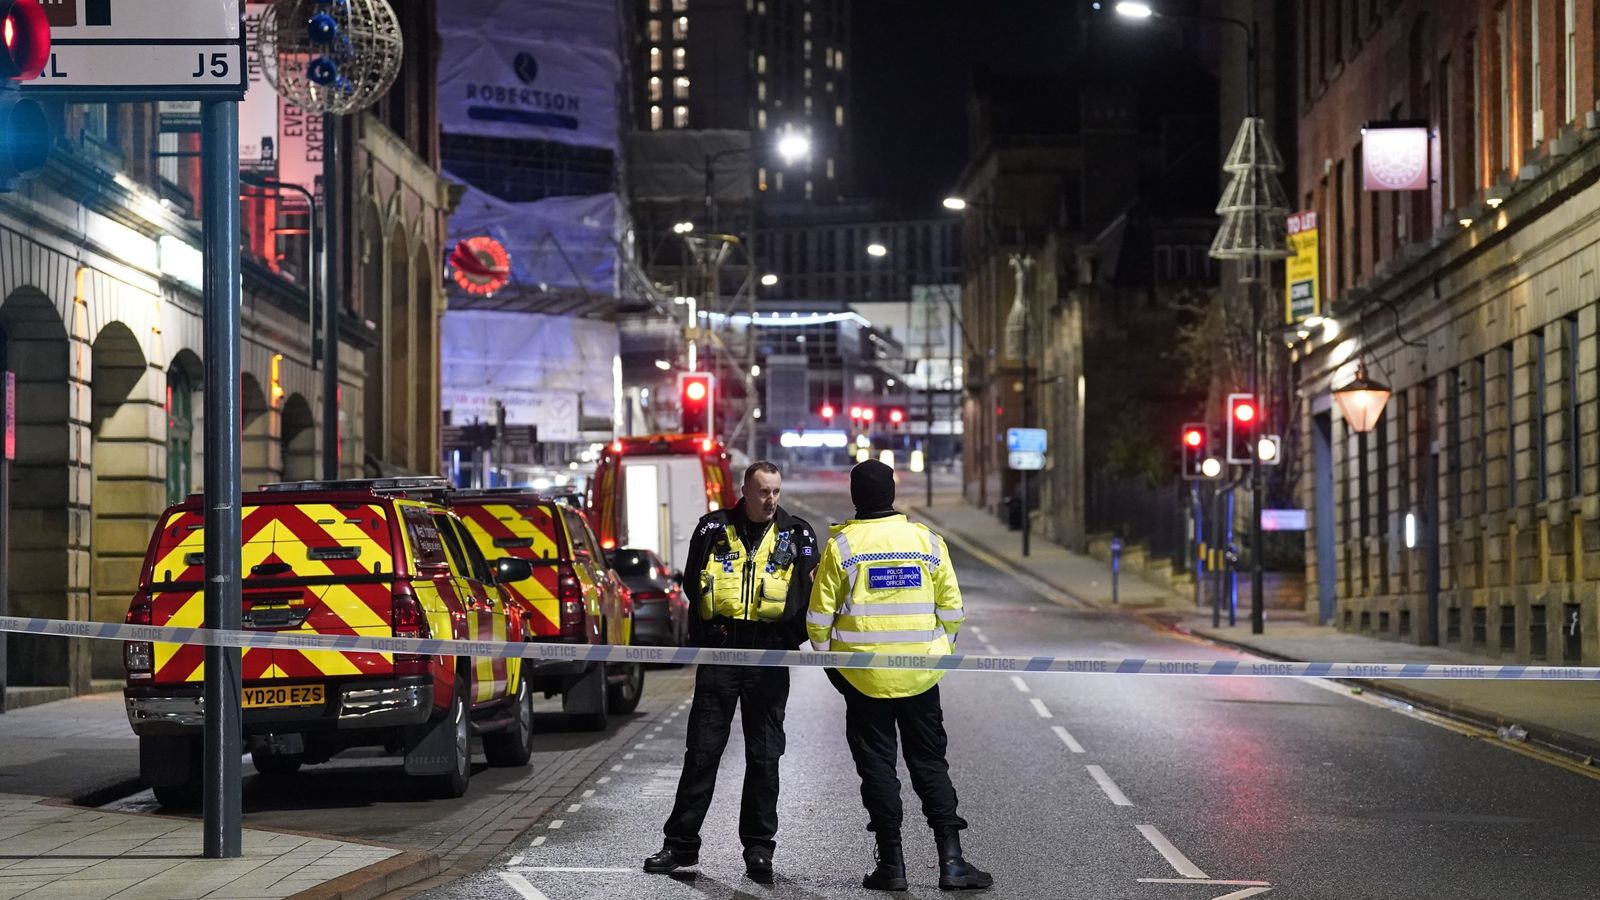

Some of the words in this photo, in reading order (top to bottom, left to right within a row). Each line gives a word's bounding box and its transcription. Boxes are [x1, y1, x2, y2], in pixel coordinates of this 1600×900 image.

[192, 53, 229, 78] J5
[465, 83, 580, 112] ROBERTSON
[244, 689, 286, 705] YD20
[290, 687, 322, 703] EZS
